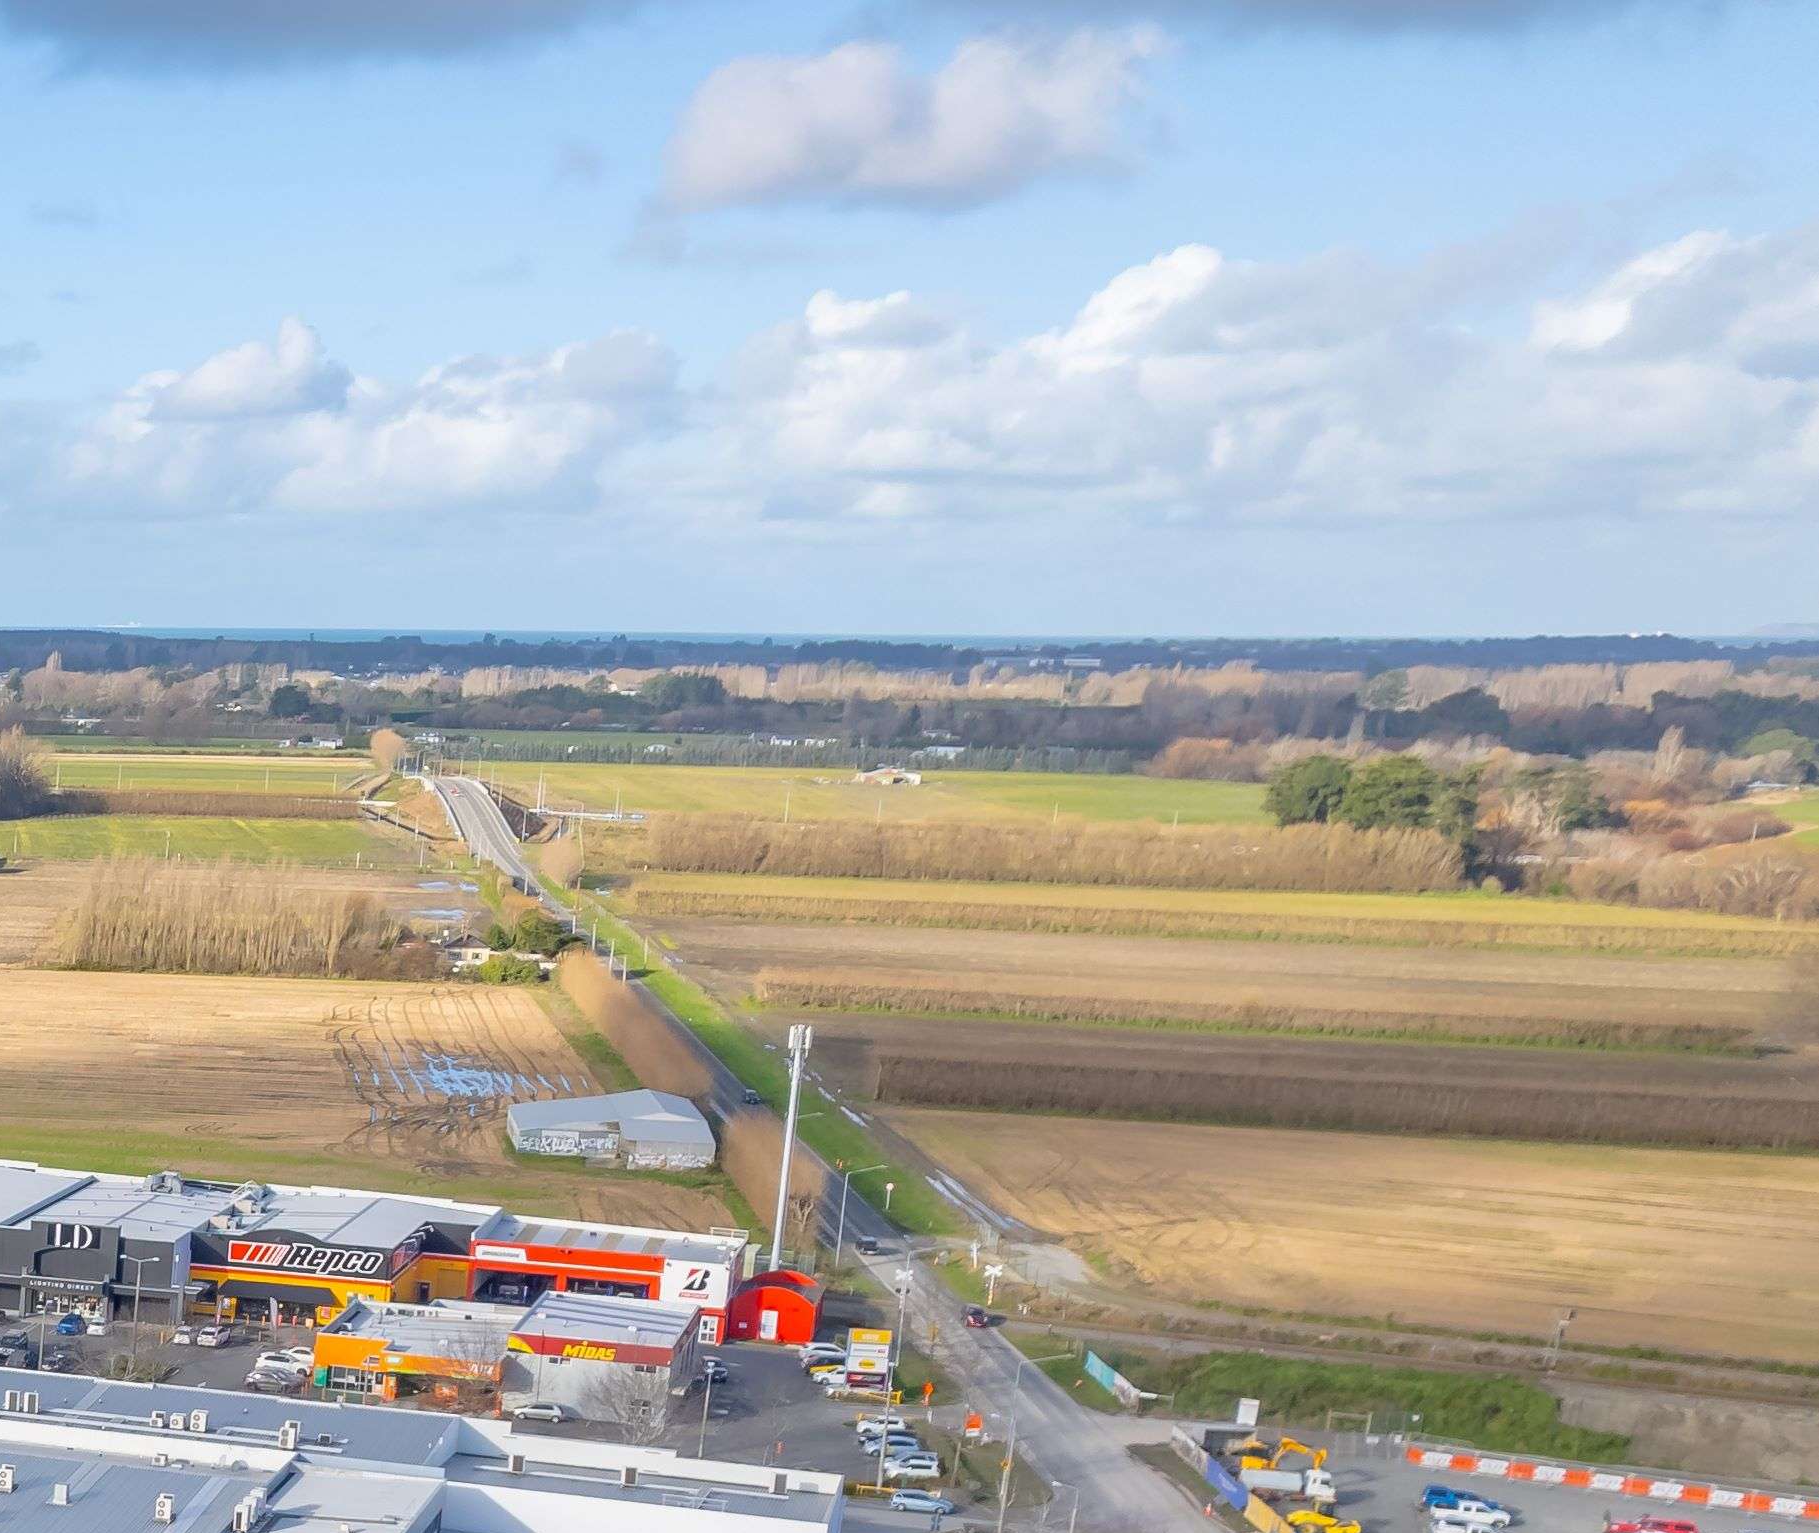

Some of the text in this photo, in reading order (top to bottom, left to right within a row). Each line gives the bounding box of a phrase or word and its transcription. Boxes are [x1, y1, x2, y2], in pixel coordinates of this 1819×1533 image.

[54, 1223, 93, 1249] LD
[284, 1242, 384, 1275] Repco
[29, 1280, 95, 1292] LIGHTING DIRECT
